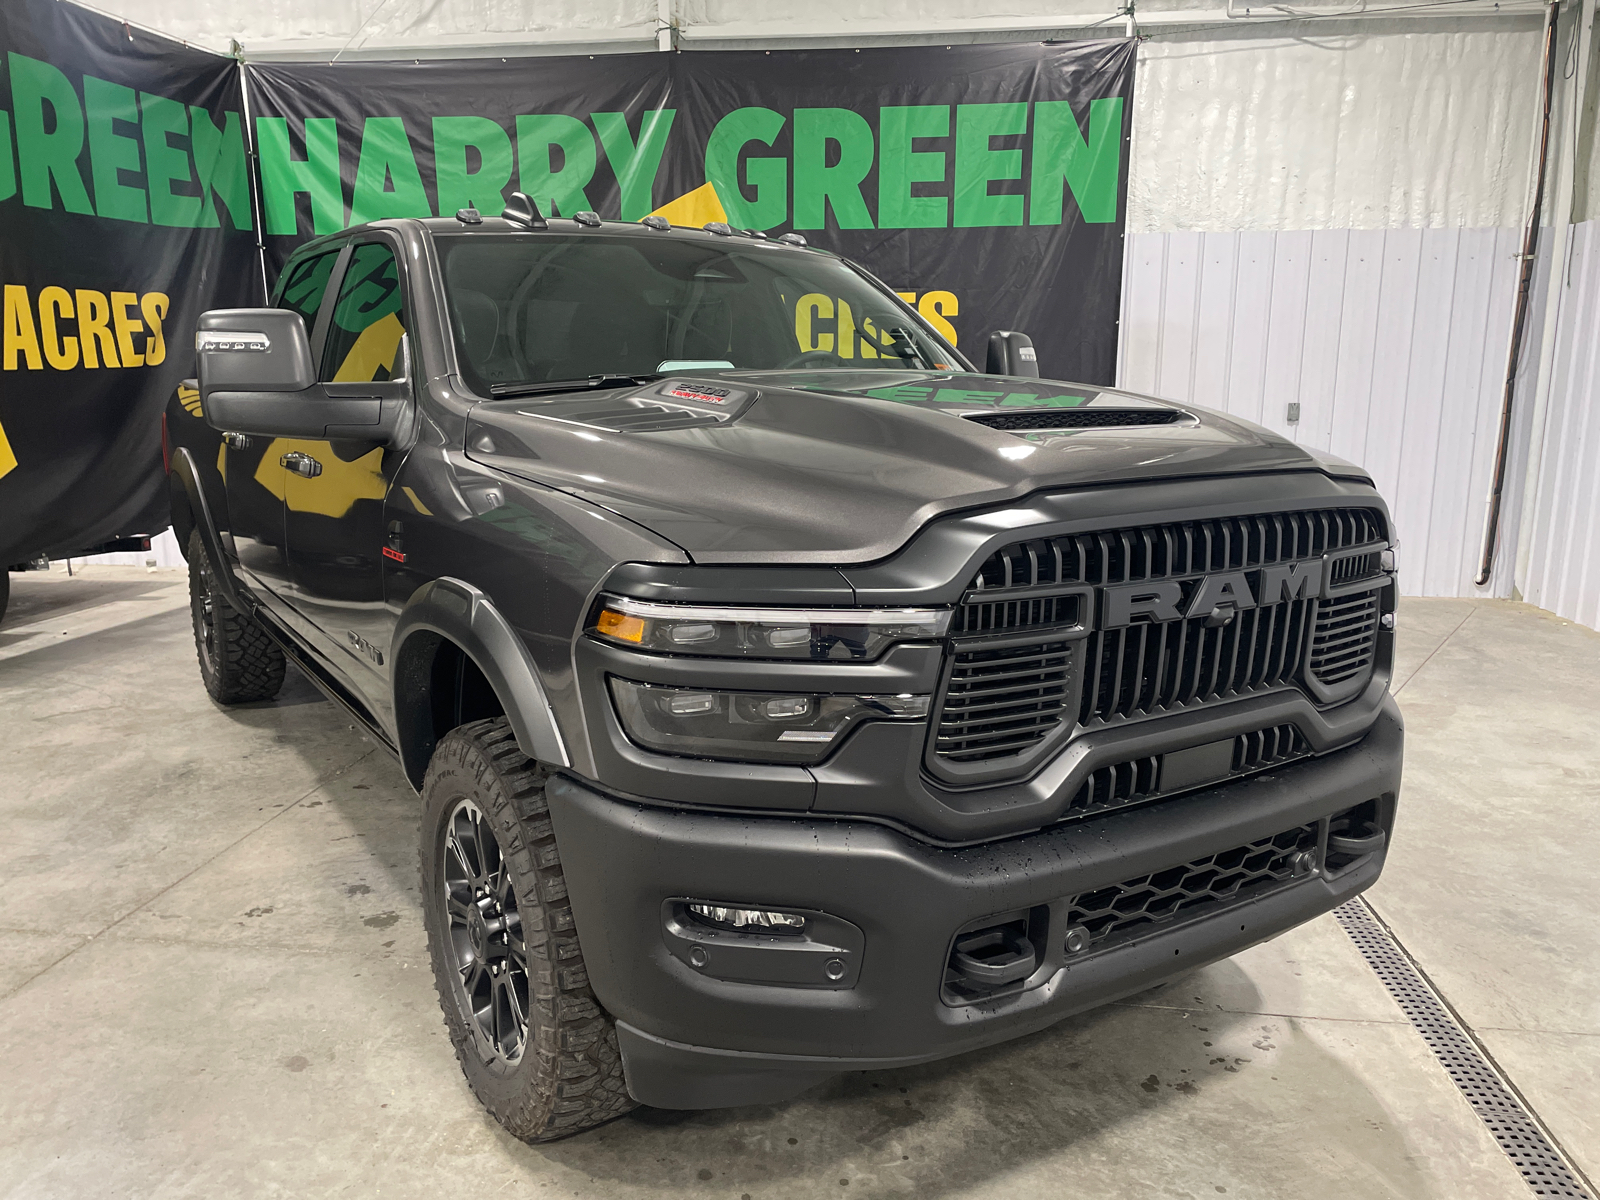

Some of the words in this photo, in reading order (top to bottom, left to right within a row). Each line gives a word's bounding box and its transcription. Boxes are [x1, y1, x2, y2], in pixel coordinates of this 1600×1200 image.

[0, 50, 253, 232] REEN
[256, 108, 677, 236] HARRY
[705, 97, 1124, 232] GREEN
[2, 284, 170, 371] ACRES
[780, 290, 960, 360] CRS
[675, 383, 732, 398] 2500
[1101, 558, 1323, 631] RAM
